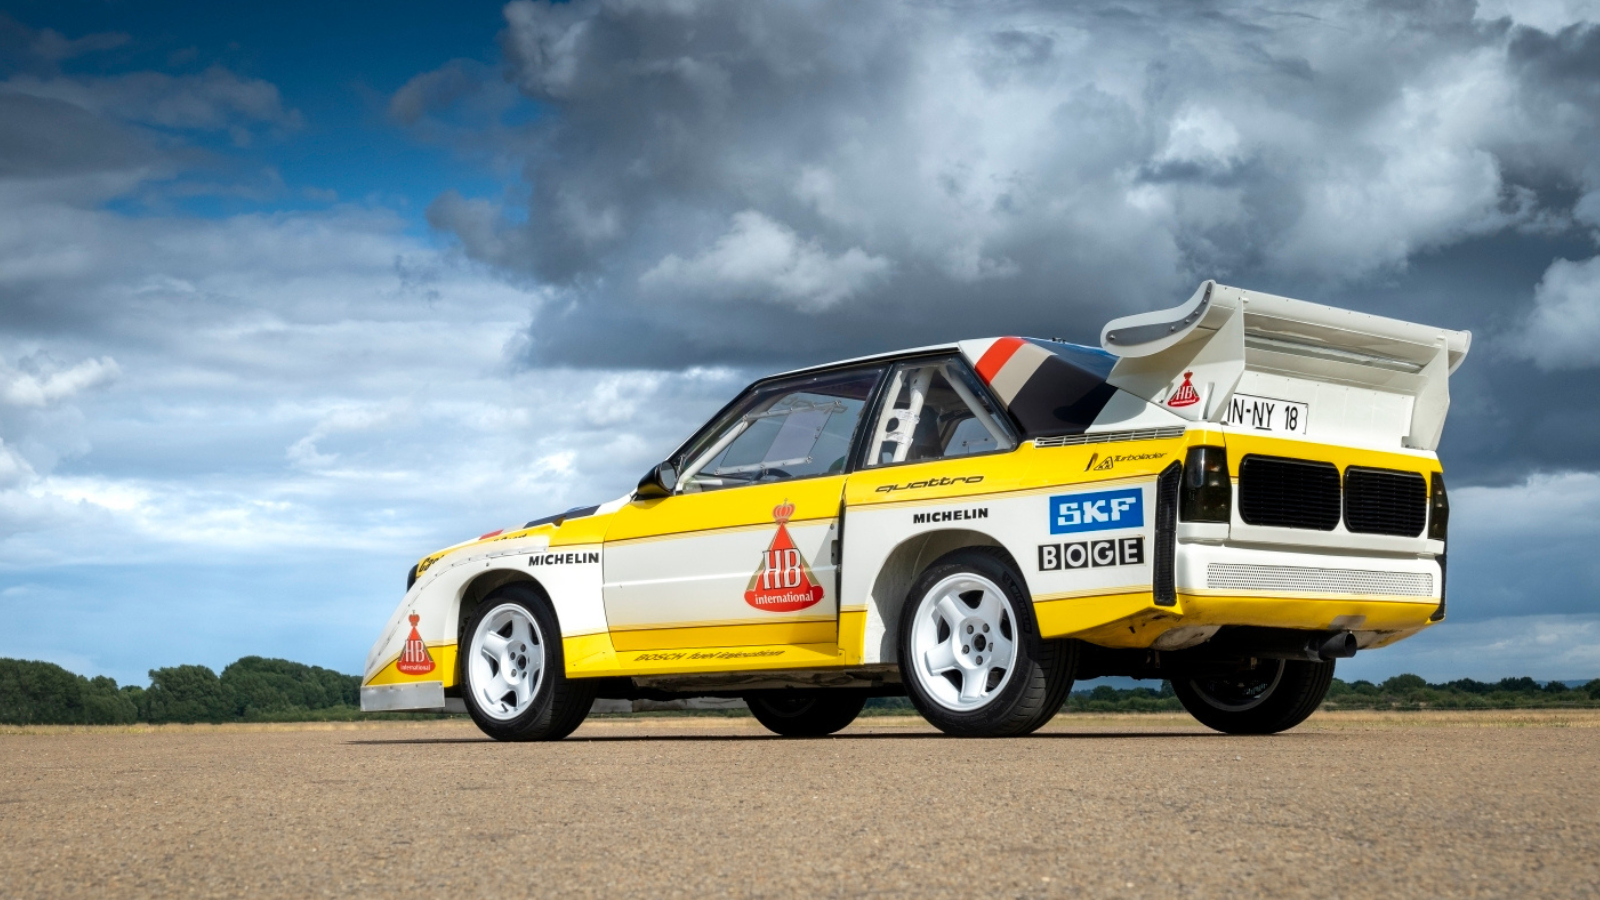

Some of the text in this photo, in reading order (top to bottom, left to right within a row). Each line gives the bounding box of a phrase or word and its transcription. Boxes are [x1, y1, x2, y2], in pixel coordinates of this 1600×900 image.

[1176, 385, 1194, 400] HB
[1284, 405, 1299, 431] 18
[875, 475, 984, 493] quattro
[913, 507, 988, 524] MICHELIN
[1057, 497, 1137, 526] SKF
[528, 552, 599, 567] MICHELIN
[1042, 539, 1138, 570] BOGE
[762, 548, 802, 590] HB
[755, 591, 814, 606] international
[404, 640, 425, 662] HB
